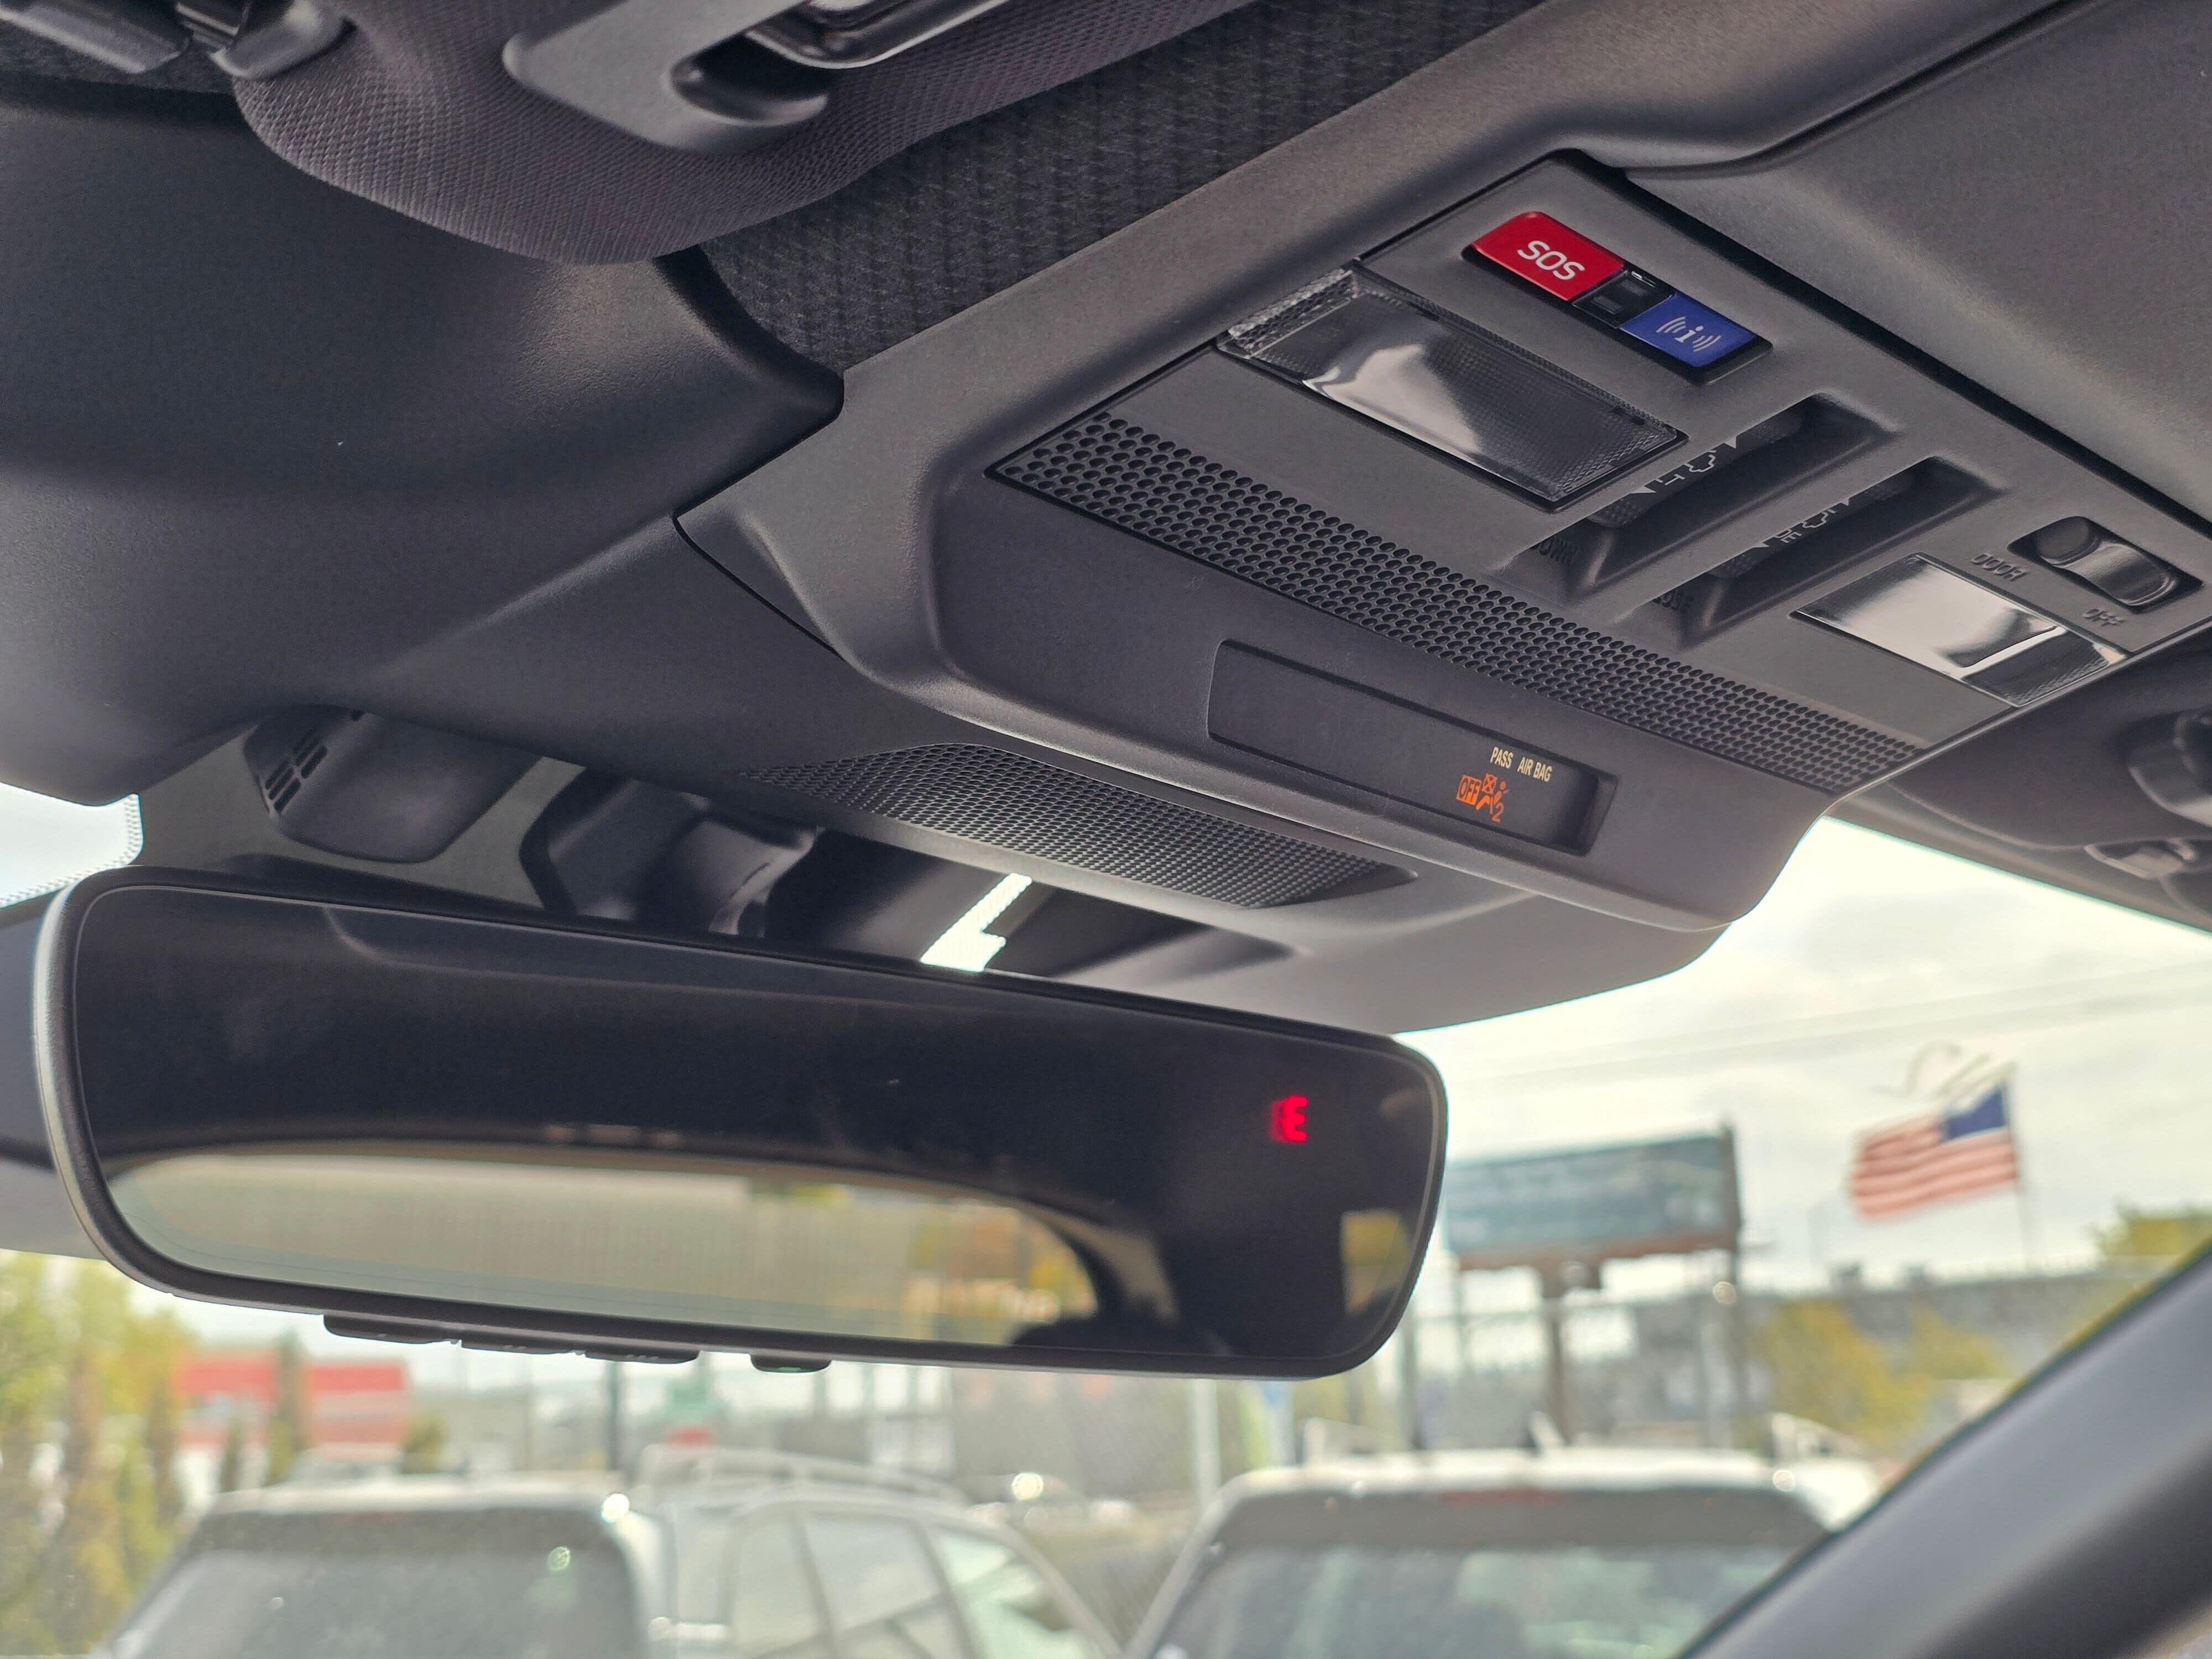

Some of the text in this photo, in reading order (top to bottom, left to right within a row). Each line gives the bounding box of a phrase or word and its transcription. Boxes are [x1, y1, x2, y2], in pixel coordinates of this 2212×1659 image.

[1517, 239, 1585, 281] SOS
[1970, 552, 2028, 582] DOOR
[2082, 607, 2125, 627] OFF
[1490, 747, 1552, 782] PASS AIR BAG
[1458, 777, 1481, 802] OFF
